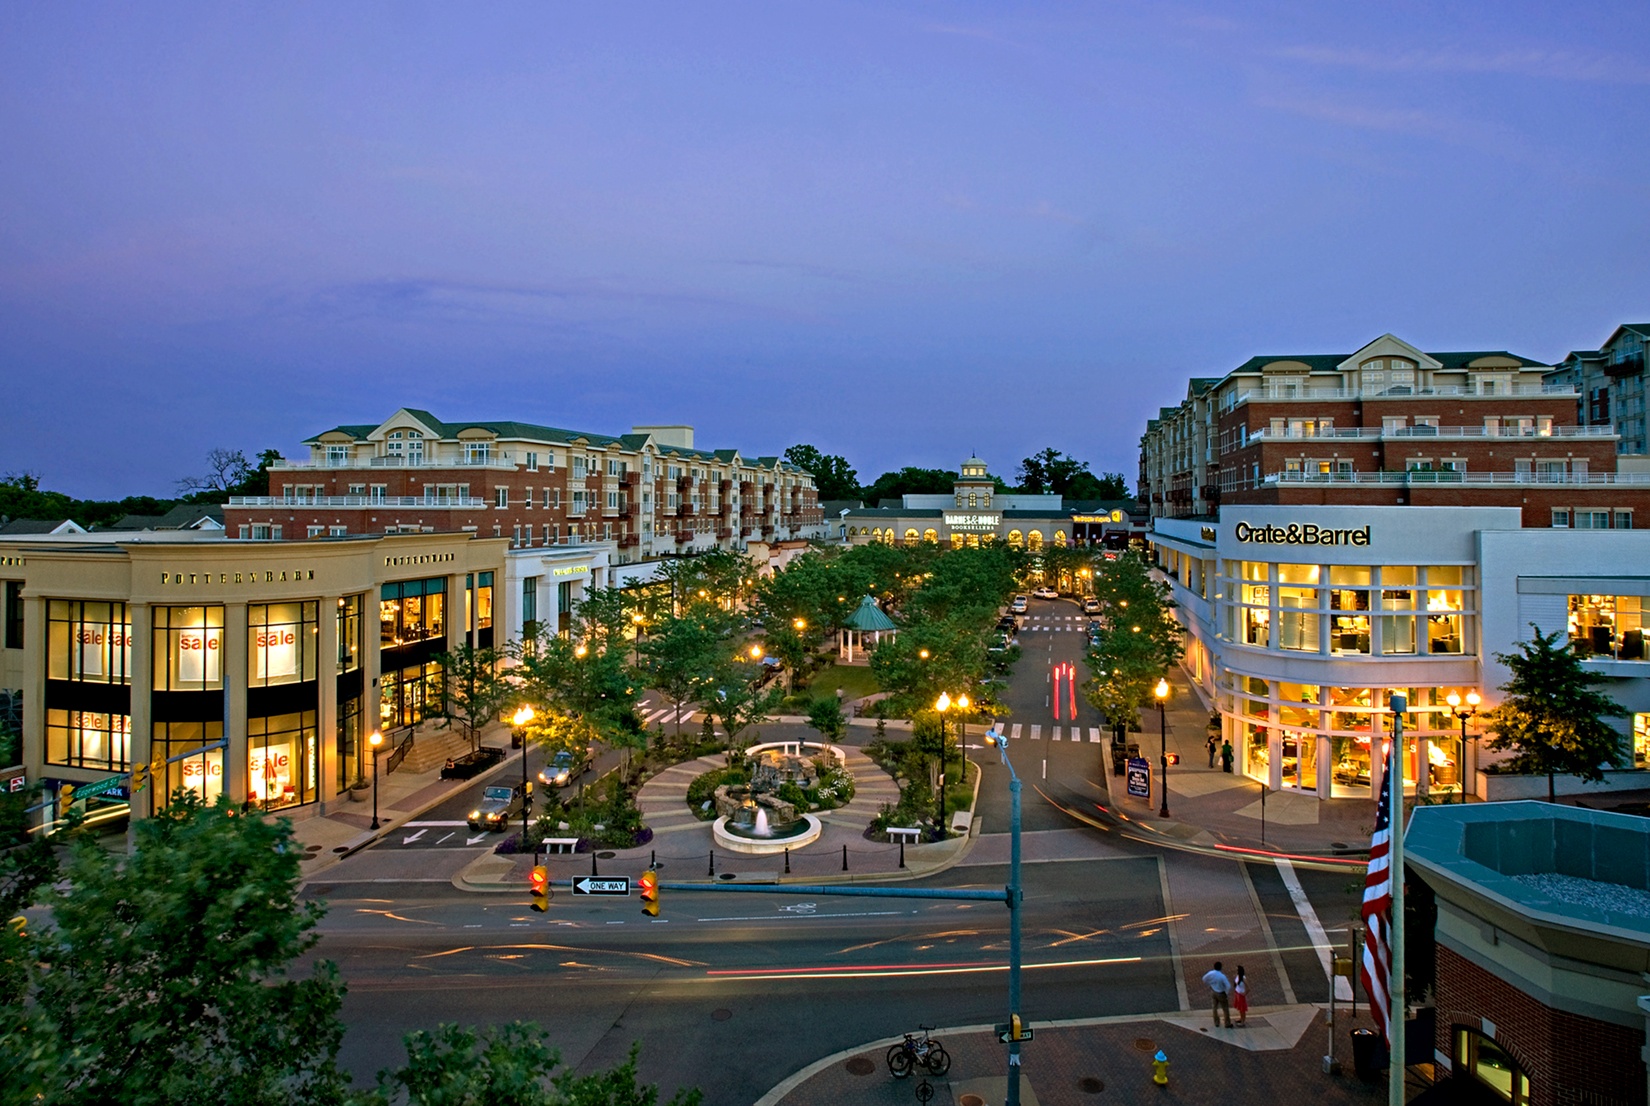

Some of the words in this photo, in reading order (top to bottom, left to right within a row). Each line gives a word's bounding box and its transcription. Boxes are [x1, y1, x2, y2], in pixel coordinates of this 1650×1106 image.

[1235, 521, 1372, 546] Crate&Barrel
[257, 630, 295, 648] sale
[183, 760, 222, 776] sale
[102, 788, 123, 797] ARK
[590, 882, 606, 890] ONE
[608, 882, 624, 890] WAY
